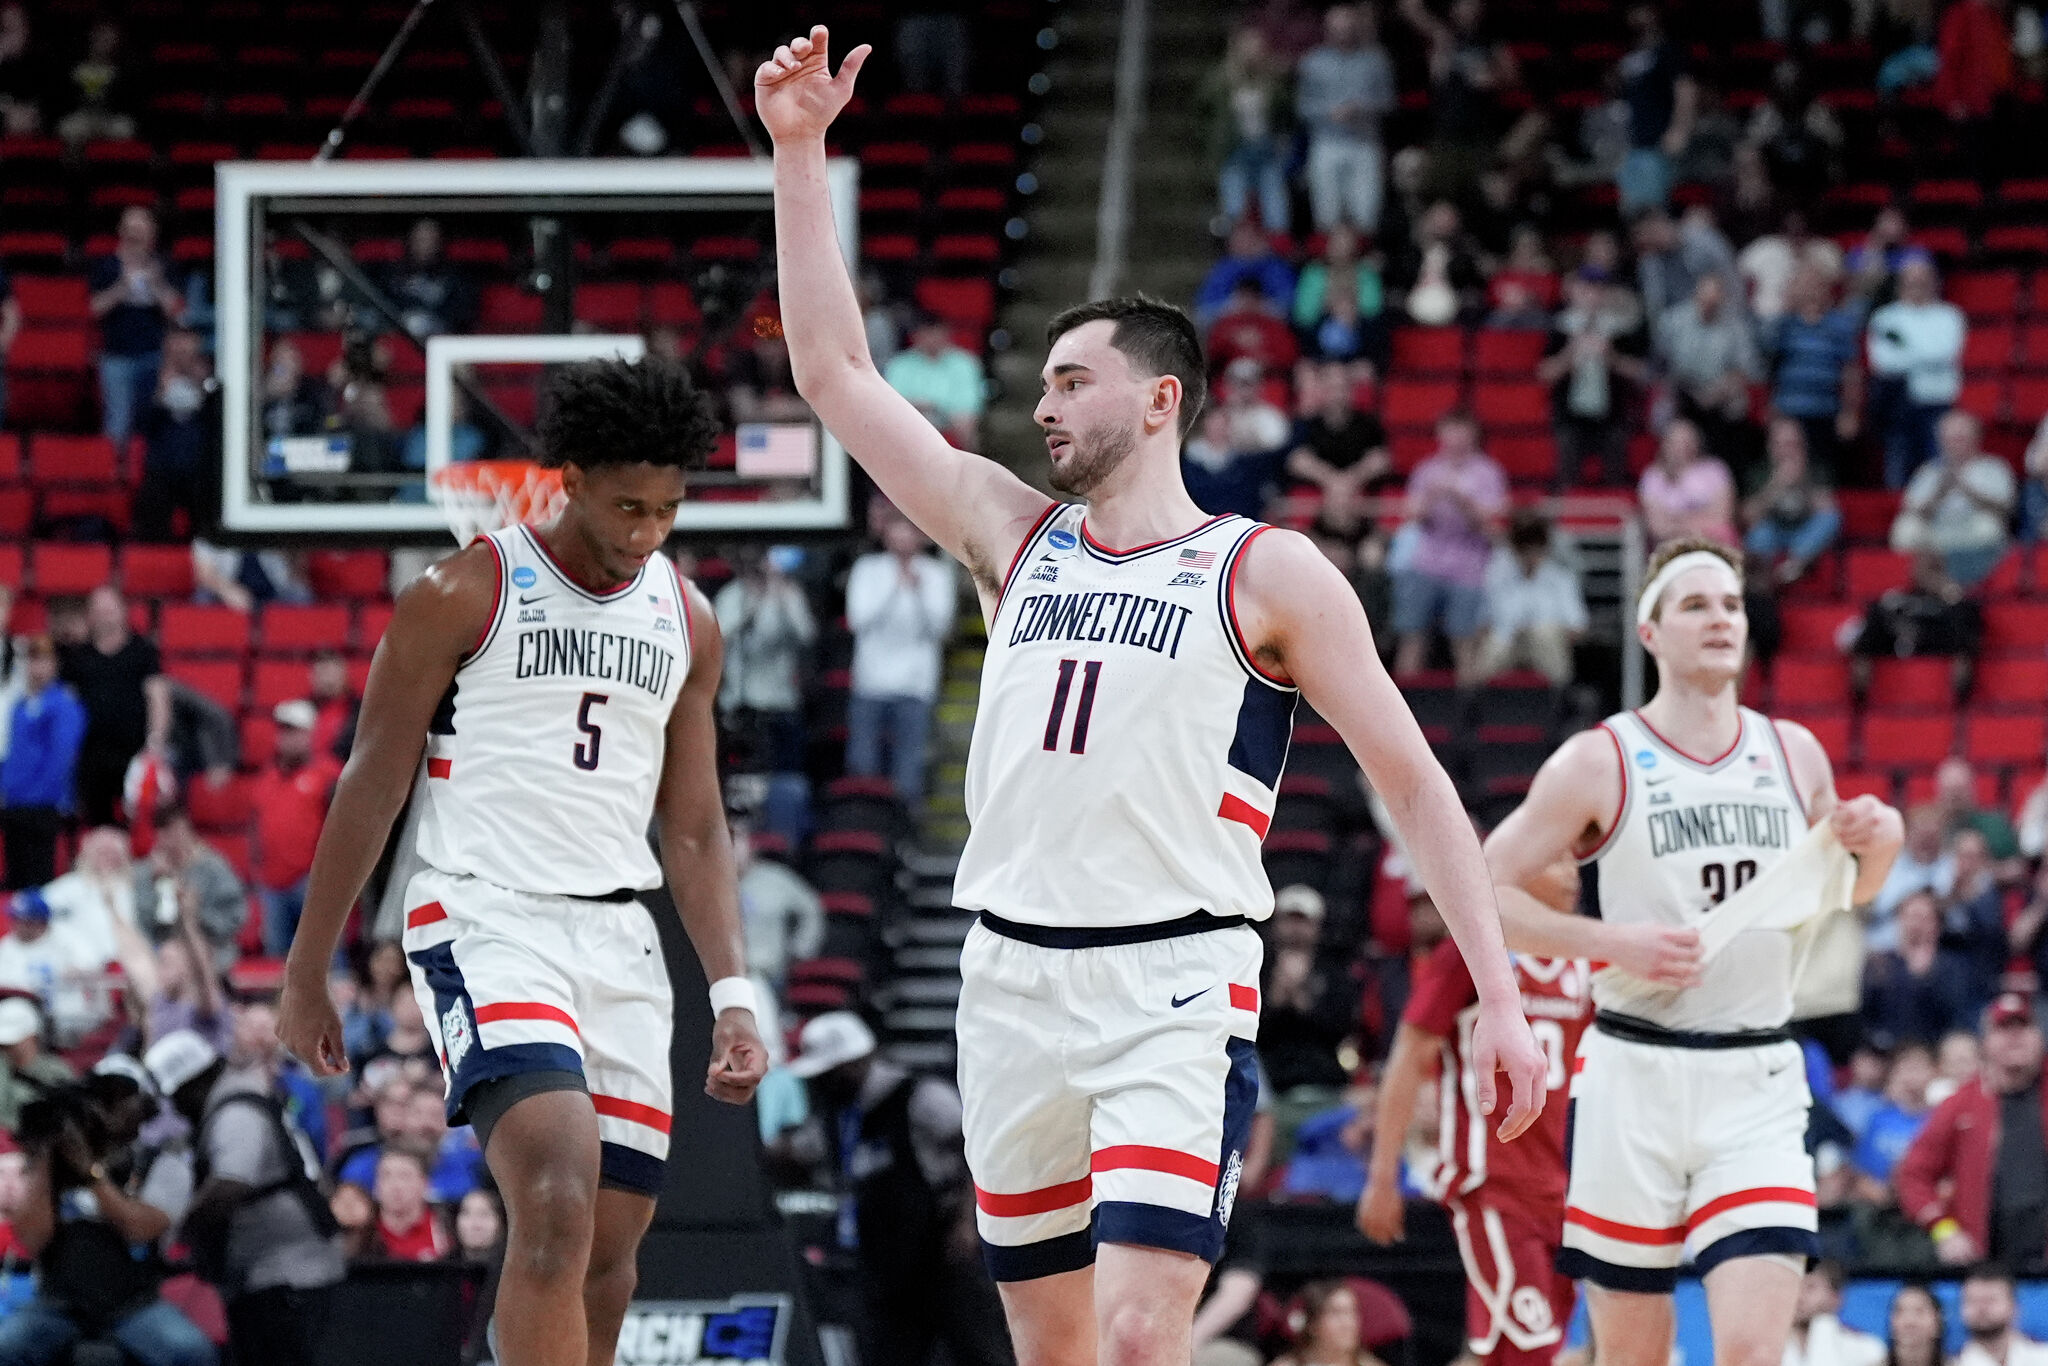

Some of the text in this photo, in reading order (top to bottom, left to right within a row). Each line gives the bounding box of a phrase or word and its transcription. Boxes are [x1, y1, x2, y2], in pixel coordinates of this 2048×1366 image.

[1044, 565, 1060, 575] THE
[1171, 577, 1207, 586] EAST
[1177, 571, 1203, 579] BIG
[1008, 592, 1193, 660] CONNECTICUT
[515, 628, 674, 701] CONNECTICUT
[573, 691, 609, 771] 5
[1043, 659, 1103, 755] 11
[1648, 803, 1790, 858] CONNECTICUT
[617, 1312, 703, 1361] RCH
